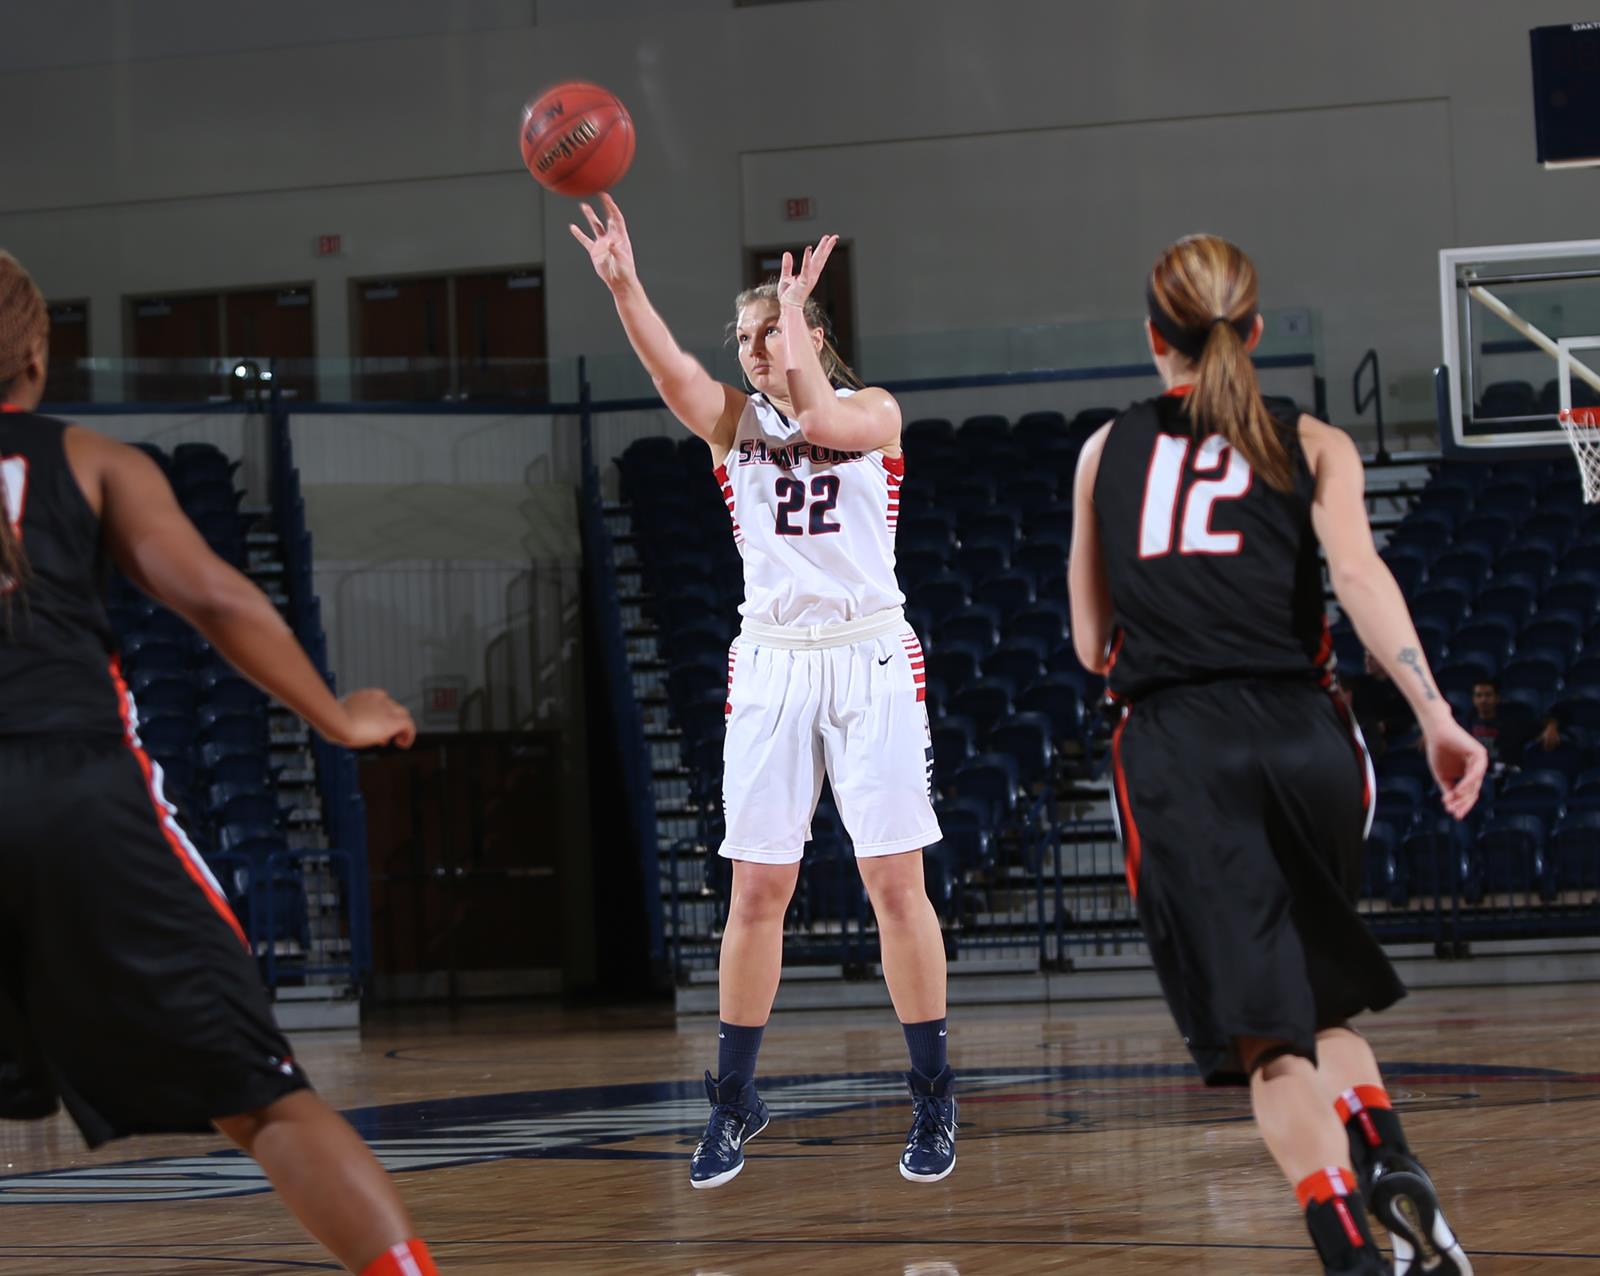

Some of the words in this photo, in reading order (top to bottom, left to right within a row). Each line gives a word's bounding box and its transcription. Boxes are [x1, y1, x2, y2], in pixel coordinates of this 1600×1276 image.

[1571, 21, 1600, 31] DAKT
[535, 117, 600, 173] Wilson
[774, 474, 841, 536] 22
[1138, 432, 1254, 560] 12
